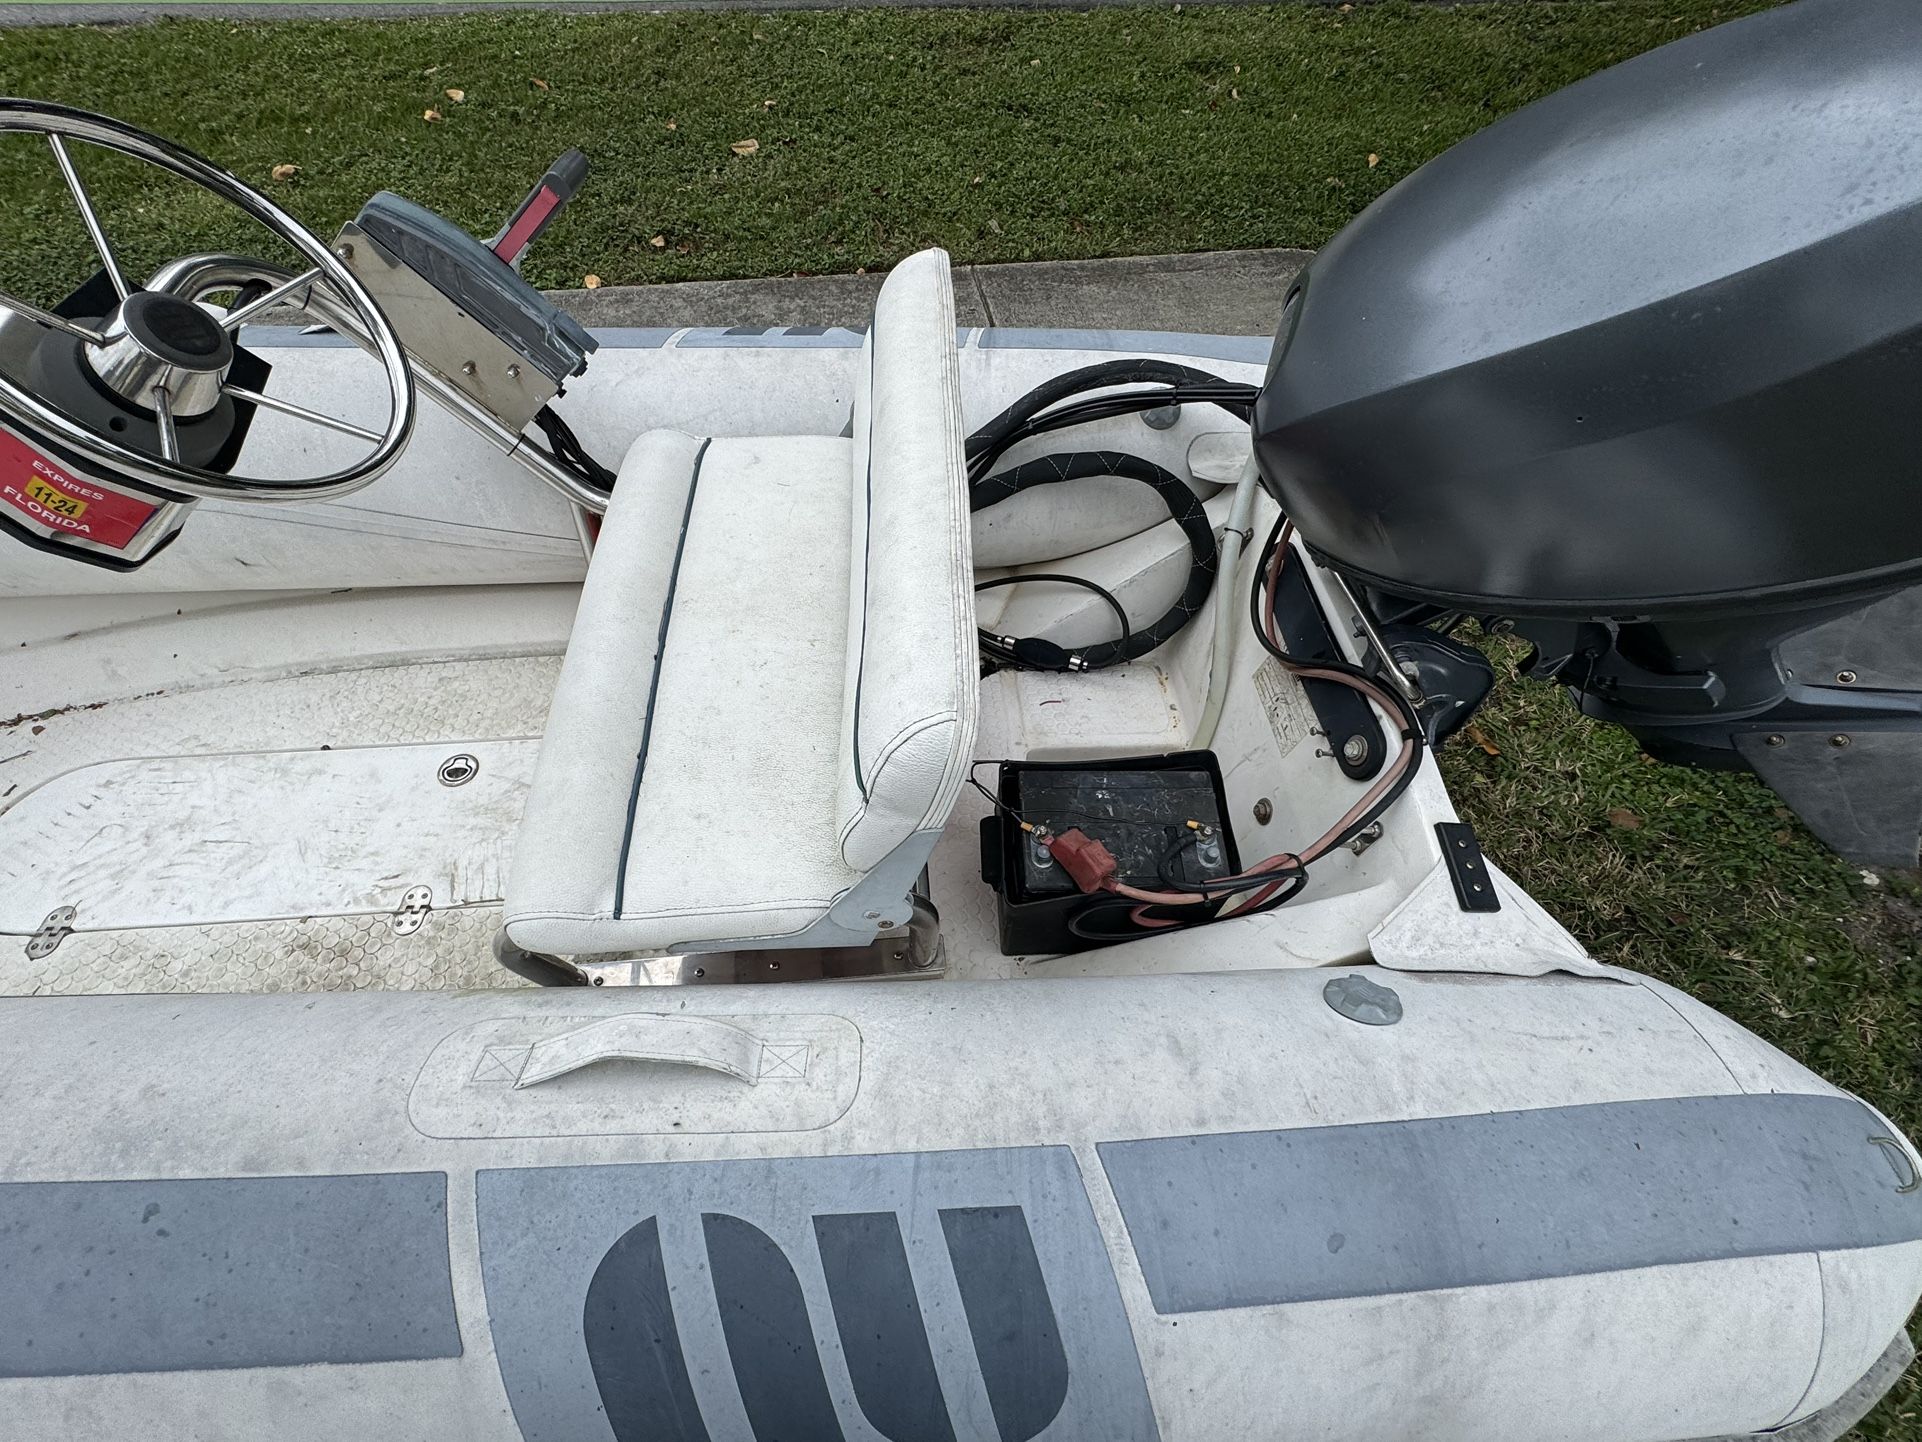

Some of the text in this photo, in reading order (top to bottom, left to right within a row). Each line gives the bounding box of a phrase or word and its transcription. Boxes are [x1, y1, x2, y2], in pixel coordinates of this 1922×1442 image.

[32, 460, 104, 500] EXPIRES
[3, 485, 91, 532] FLORIDA
[34, 486, 78, 516] 11-24
